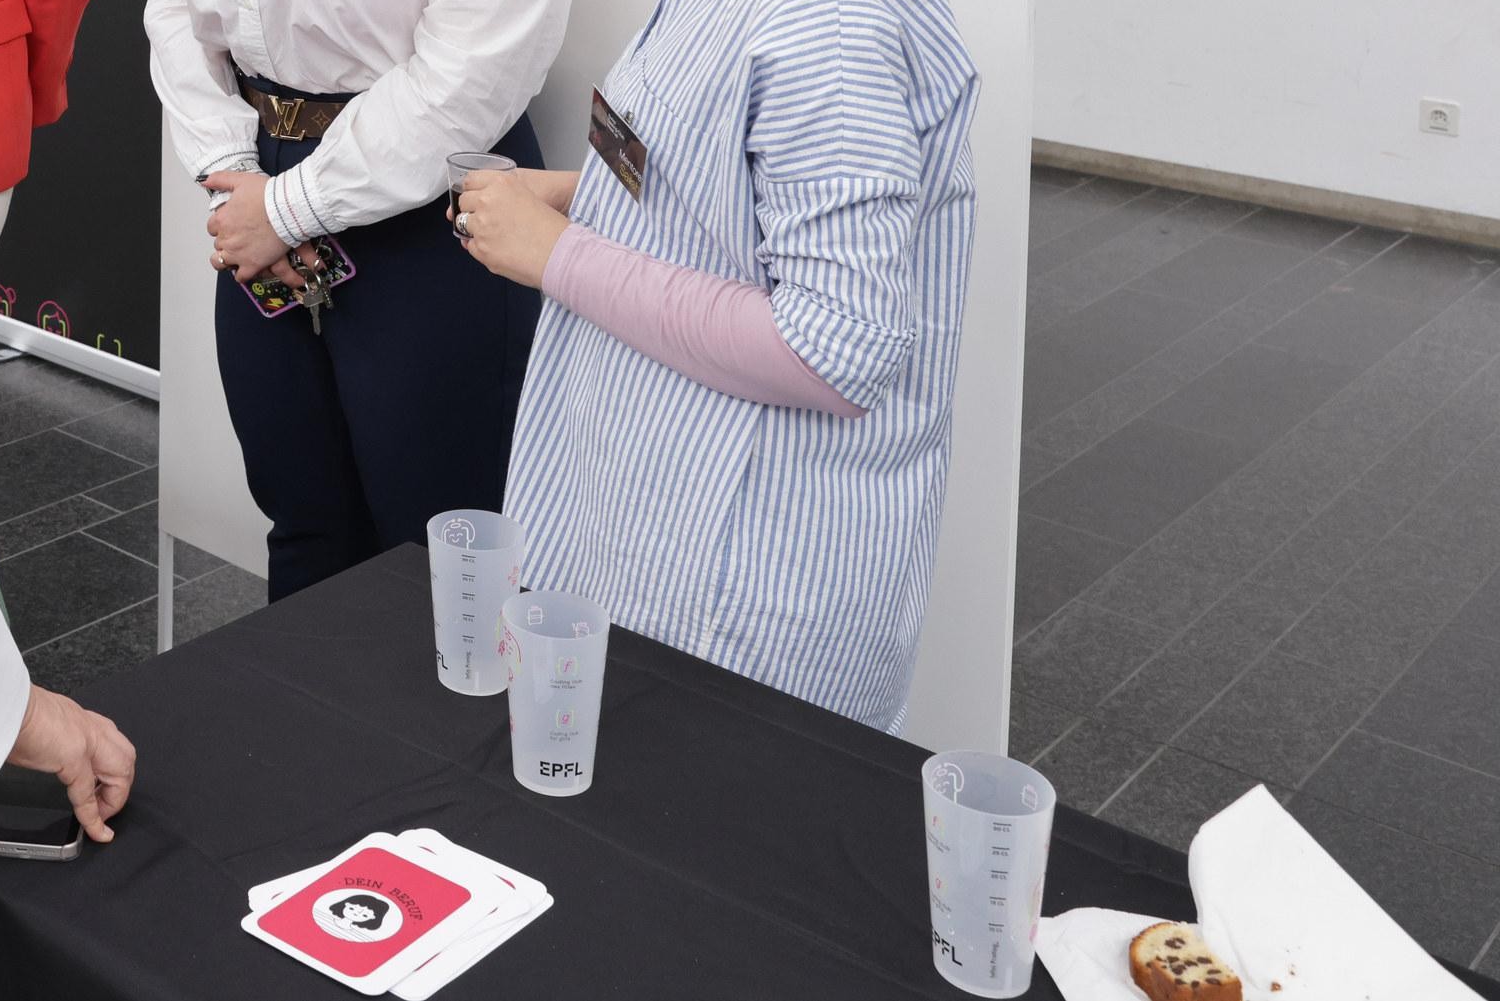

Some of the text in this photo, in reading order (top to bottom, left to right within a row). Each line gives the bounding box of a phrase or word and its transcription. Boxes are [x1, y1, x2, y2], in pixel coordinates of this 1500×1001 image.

[539, 760, 584, 778] EPFL
[343, 877, 384, 889] DEIN
[388, 887, 424, 921] BERUF
